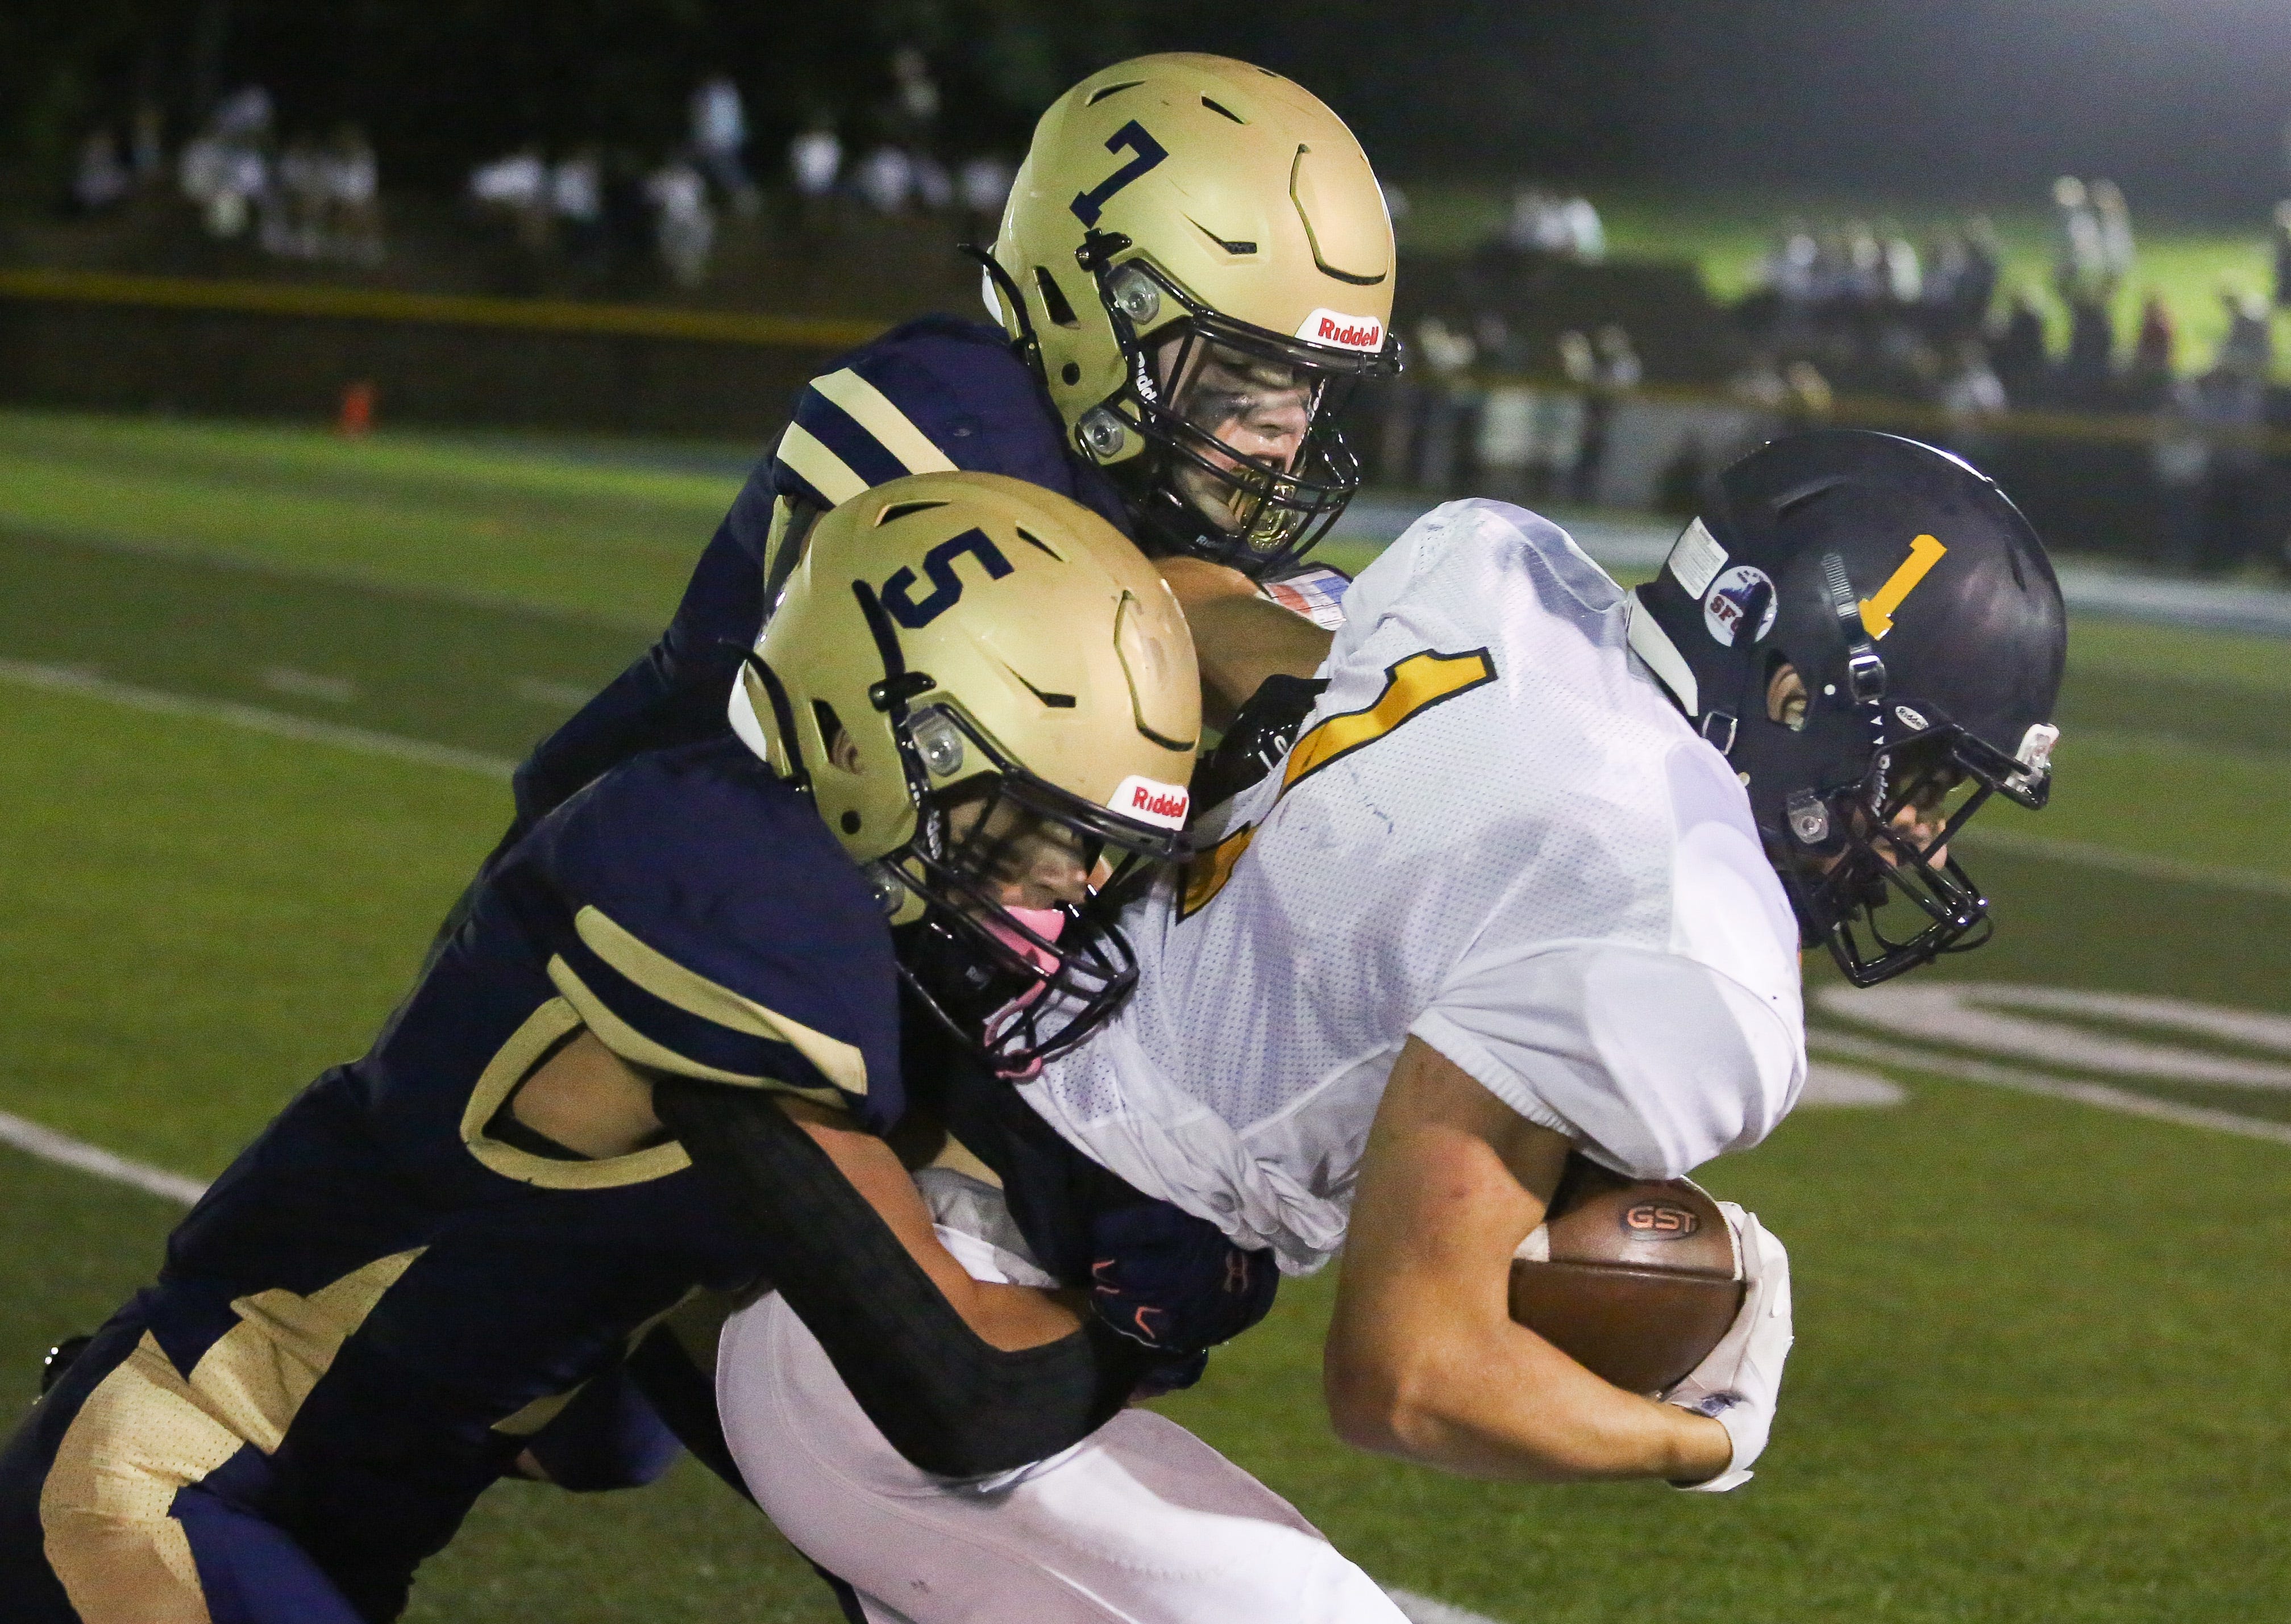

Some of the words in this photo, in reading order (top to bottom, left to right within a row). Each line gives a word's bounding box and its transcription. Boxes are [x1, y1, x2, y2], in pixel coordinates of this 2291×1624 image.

[1069, 119, 1169, 229] 7
[1318, 317, 1379, 347] Riddell
[880, 527, 1014, 629] 5
[1858, 534, 1947, 640] 1
[1627, 1205, 1696, 1233] GST
